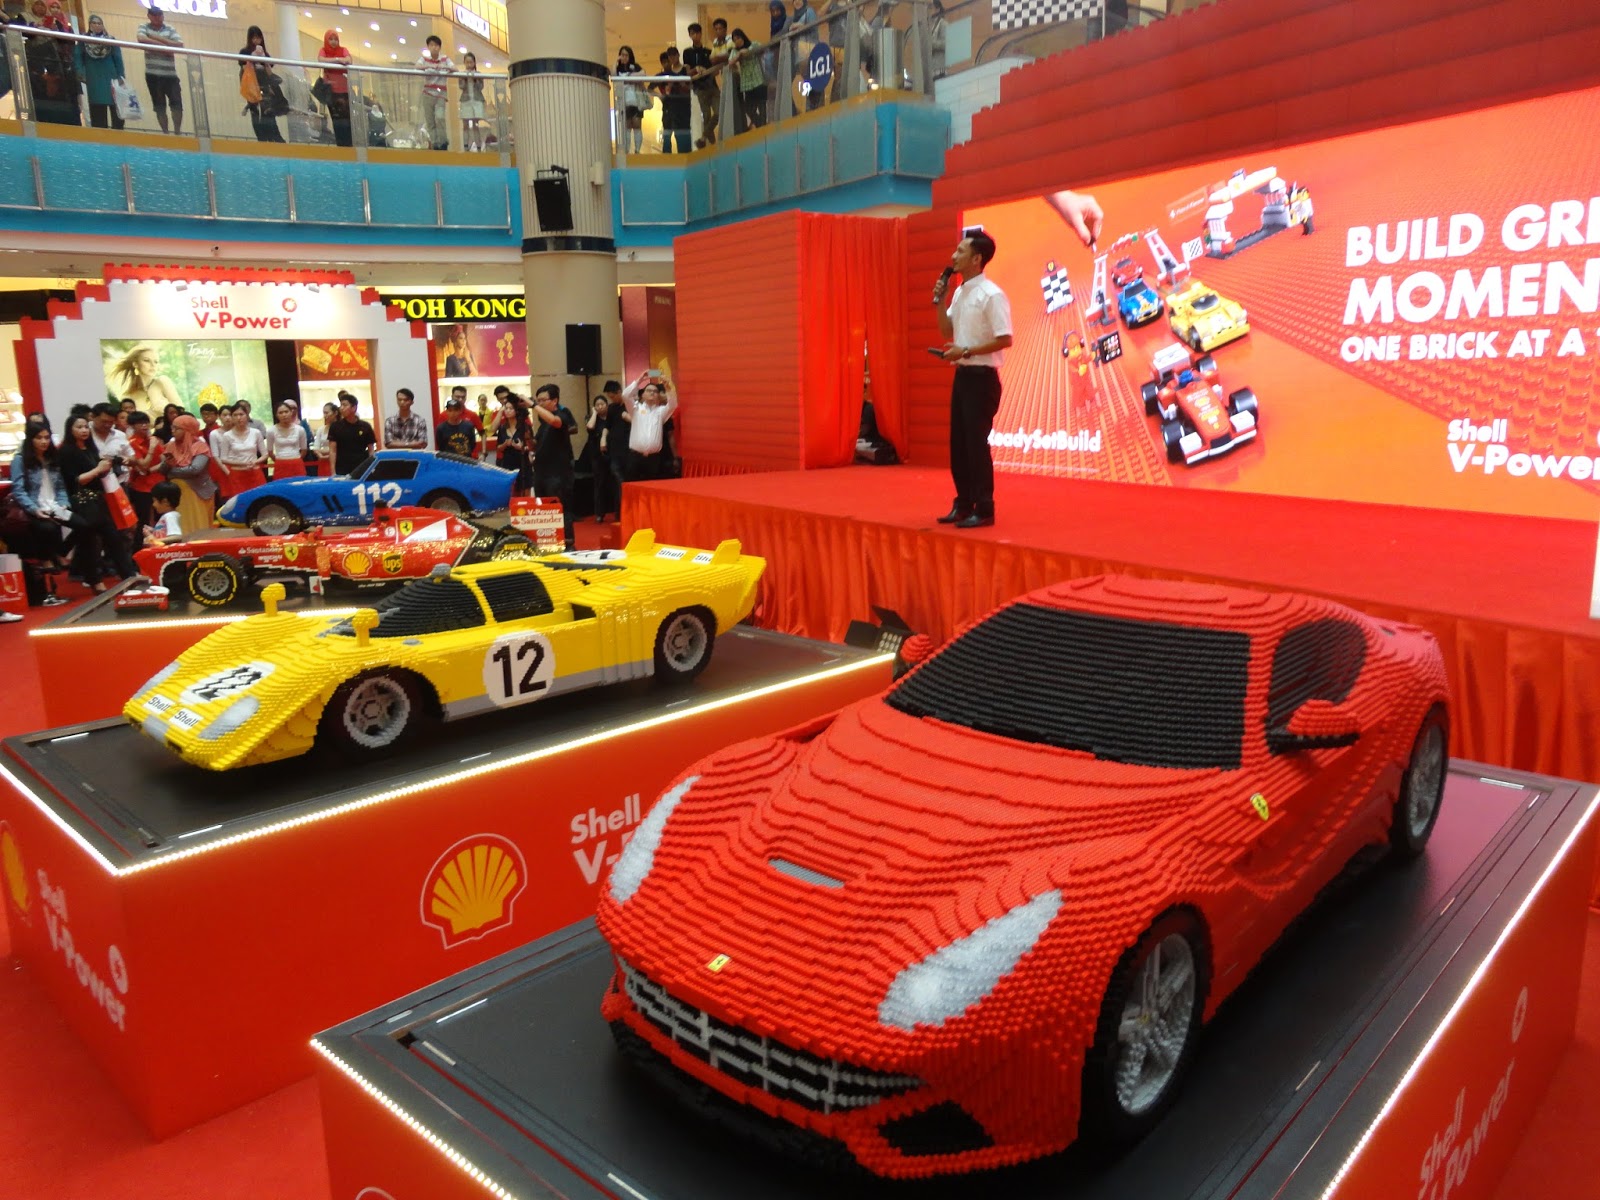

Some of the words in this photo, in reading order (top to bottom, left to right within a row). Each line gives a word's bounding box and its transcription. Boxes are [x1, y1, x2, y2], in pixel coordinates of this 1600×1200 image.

[810, 54, 831, 79] LG1
[1346, 213, 1485, 267] BUILD
[191, 296, 228, 308] Shell
[1343, 258, 1600, 325] MOMEN
[453, 298, 526, 318] KONG
[193, 312, 291, 329] V-Power
[1340, 335, 1401, 362] ONE
[1409, 331, 1499, 360] BRICK
[1507, 329, 1550, 357] AT
[1557, 328, 1586, 356] A
[1447, 418, 1508, 442] Shell
[352, 482, 402, 515] 112
[519, 514, 562, 524] Santander
[527, 508, 560, 516] V-Power
[384, 559, 402, 571] ups
[493, 640, 547, 698] 12
[147, 695, 171, 712] Shell
[174, 710, 199, 728] Shell
[571, 793, 641, 844] Shell
[1418, 1086, 1466, 1200] Shell
